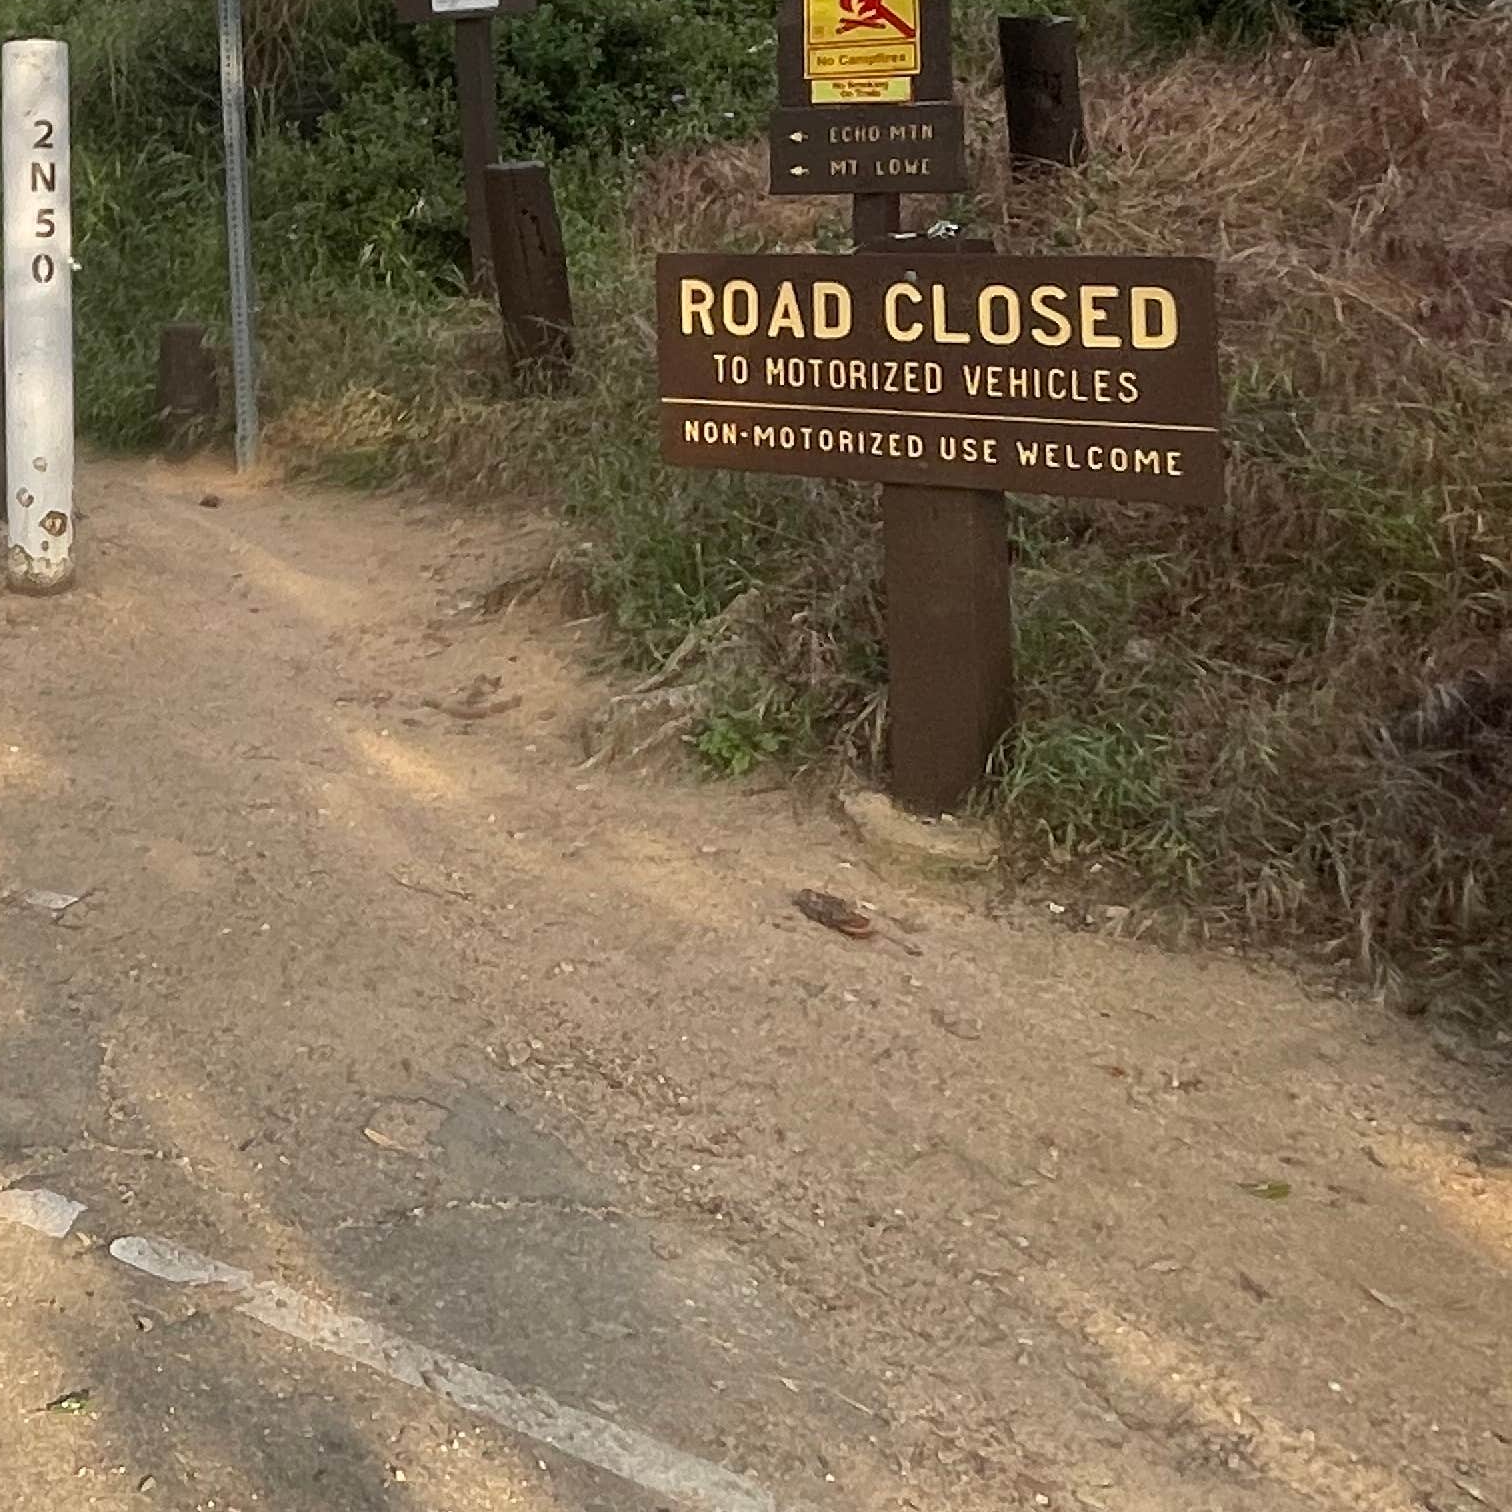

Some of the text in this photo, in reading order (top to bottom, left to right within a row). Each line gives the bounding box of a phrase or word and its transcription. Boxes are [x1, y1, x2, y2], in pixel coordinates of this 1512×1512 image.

[816, 52, 906, 66] No Campfires
[829, 123, 933, 144] ECHO MTN
[830, 157, 930, 176] MT LOWE
[680, 278, 1180, 350] ROAD CLOSED
[713, 354, 1140, 404] TO MOTORIZED VEHICLES
[684, 419, 1185, 477] NON-MOTORIZED USE WELCOME
